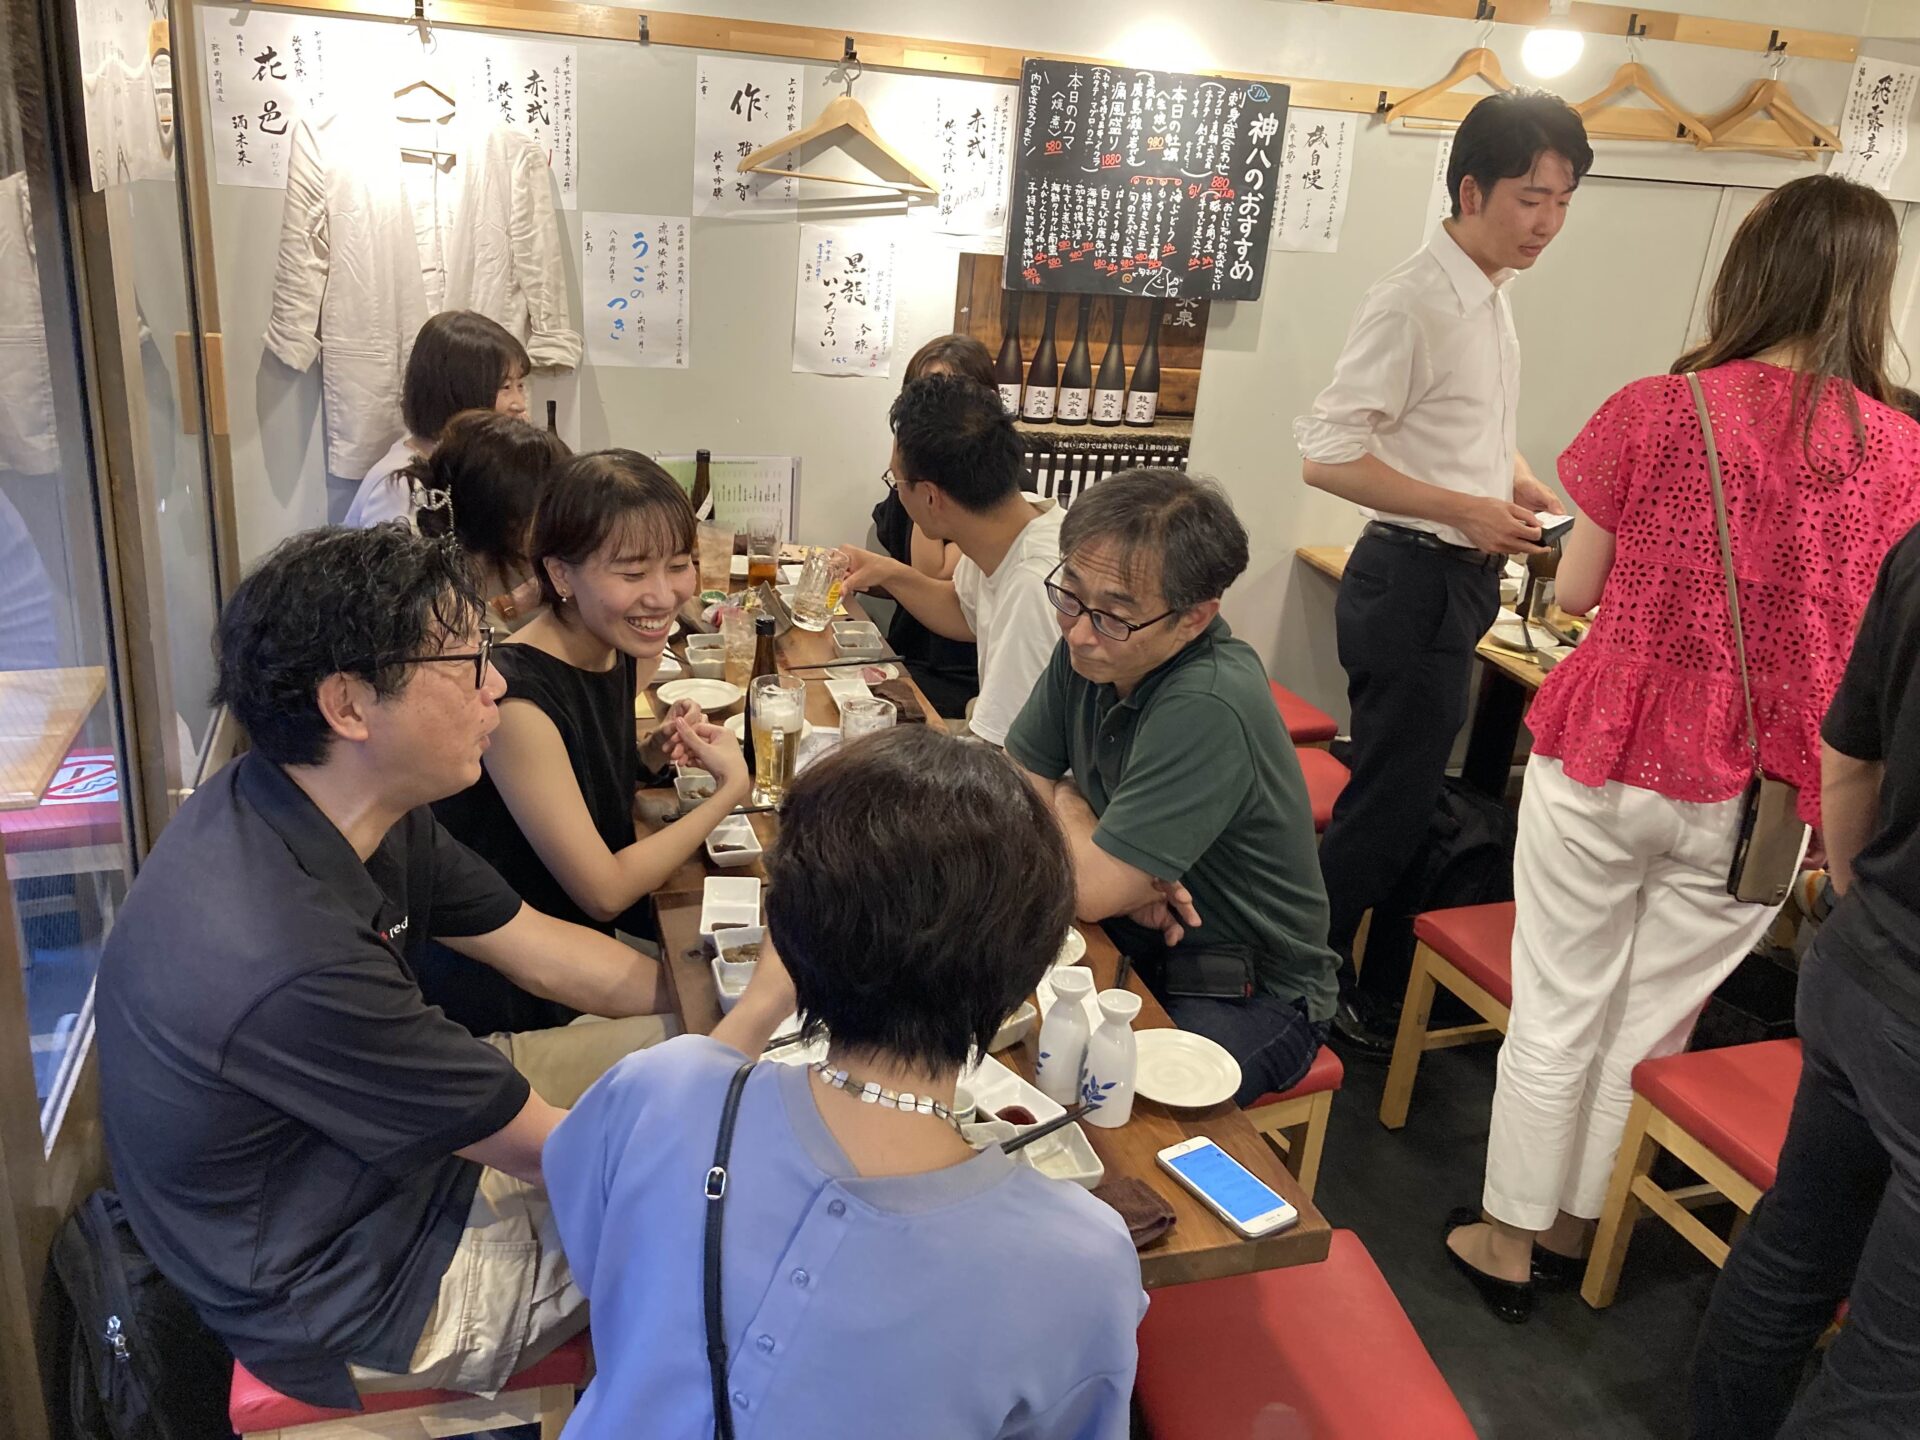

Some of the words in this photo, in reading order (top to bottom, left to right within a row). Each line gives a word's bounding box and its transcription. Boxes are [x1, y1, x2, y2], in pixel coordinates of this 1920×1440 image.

[252, 45, 289, 136] 花邑
[524, 69, 550, 126] 赤武
[730, 82, 762, 122] 作
[1062, 72, 1084, 150] 本日のカマ
[1108, 80, 1127, 151] 痛風盛り
[1859, 74, 1893, 162] 飛露喜
[231, 114, 252, 167] 酒未来
[966, 107, 986, 160] 赤武
[1045, 140, 1062, 152] 580
[1147, 136, 1164, 147] 980
[1161, 84, 1188, 162] 本日の牡蠣
[1215, 90, 1247, 176] 刺身盛合わせ
[712, 150, 724, 201] 純米吟醸
[735, 140, 753, 202] 雅智
[1102, 153, 1121, 166] 1880
[1211, 176, 1230, 188] 880
[1060, 183, 1072, 240] 牛すじ煮込み
[1095, 187, 1111, 258] 白えびの唐あげ
[1167, 187, 1183, 243] 海ぶどう
[1229, 112, 1279, 282] 神八のおすすめ
[820, 277, 839, 347] いっちょらい
